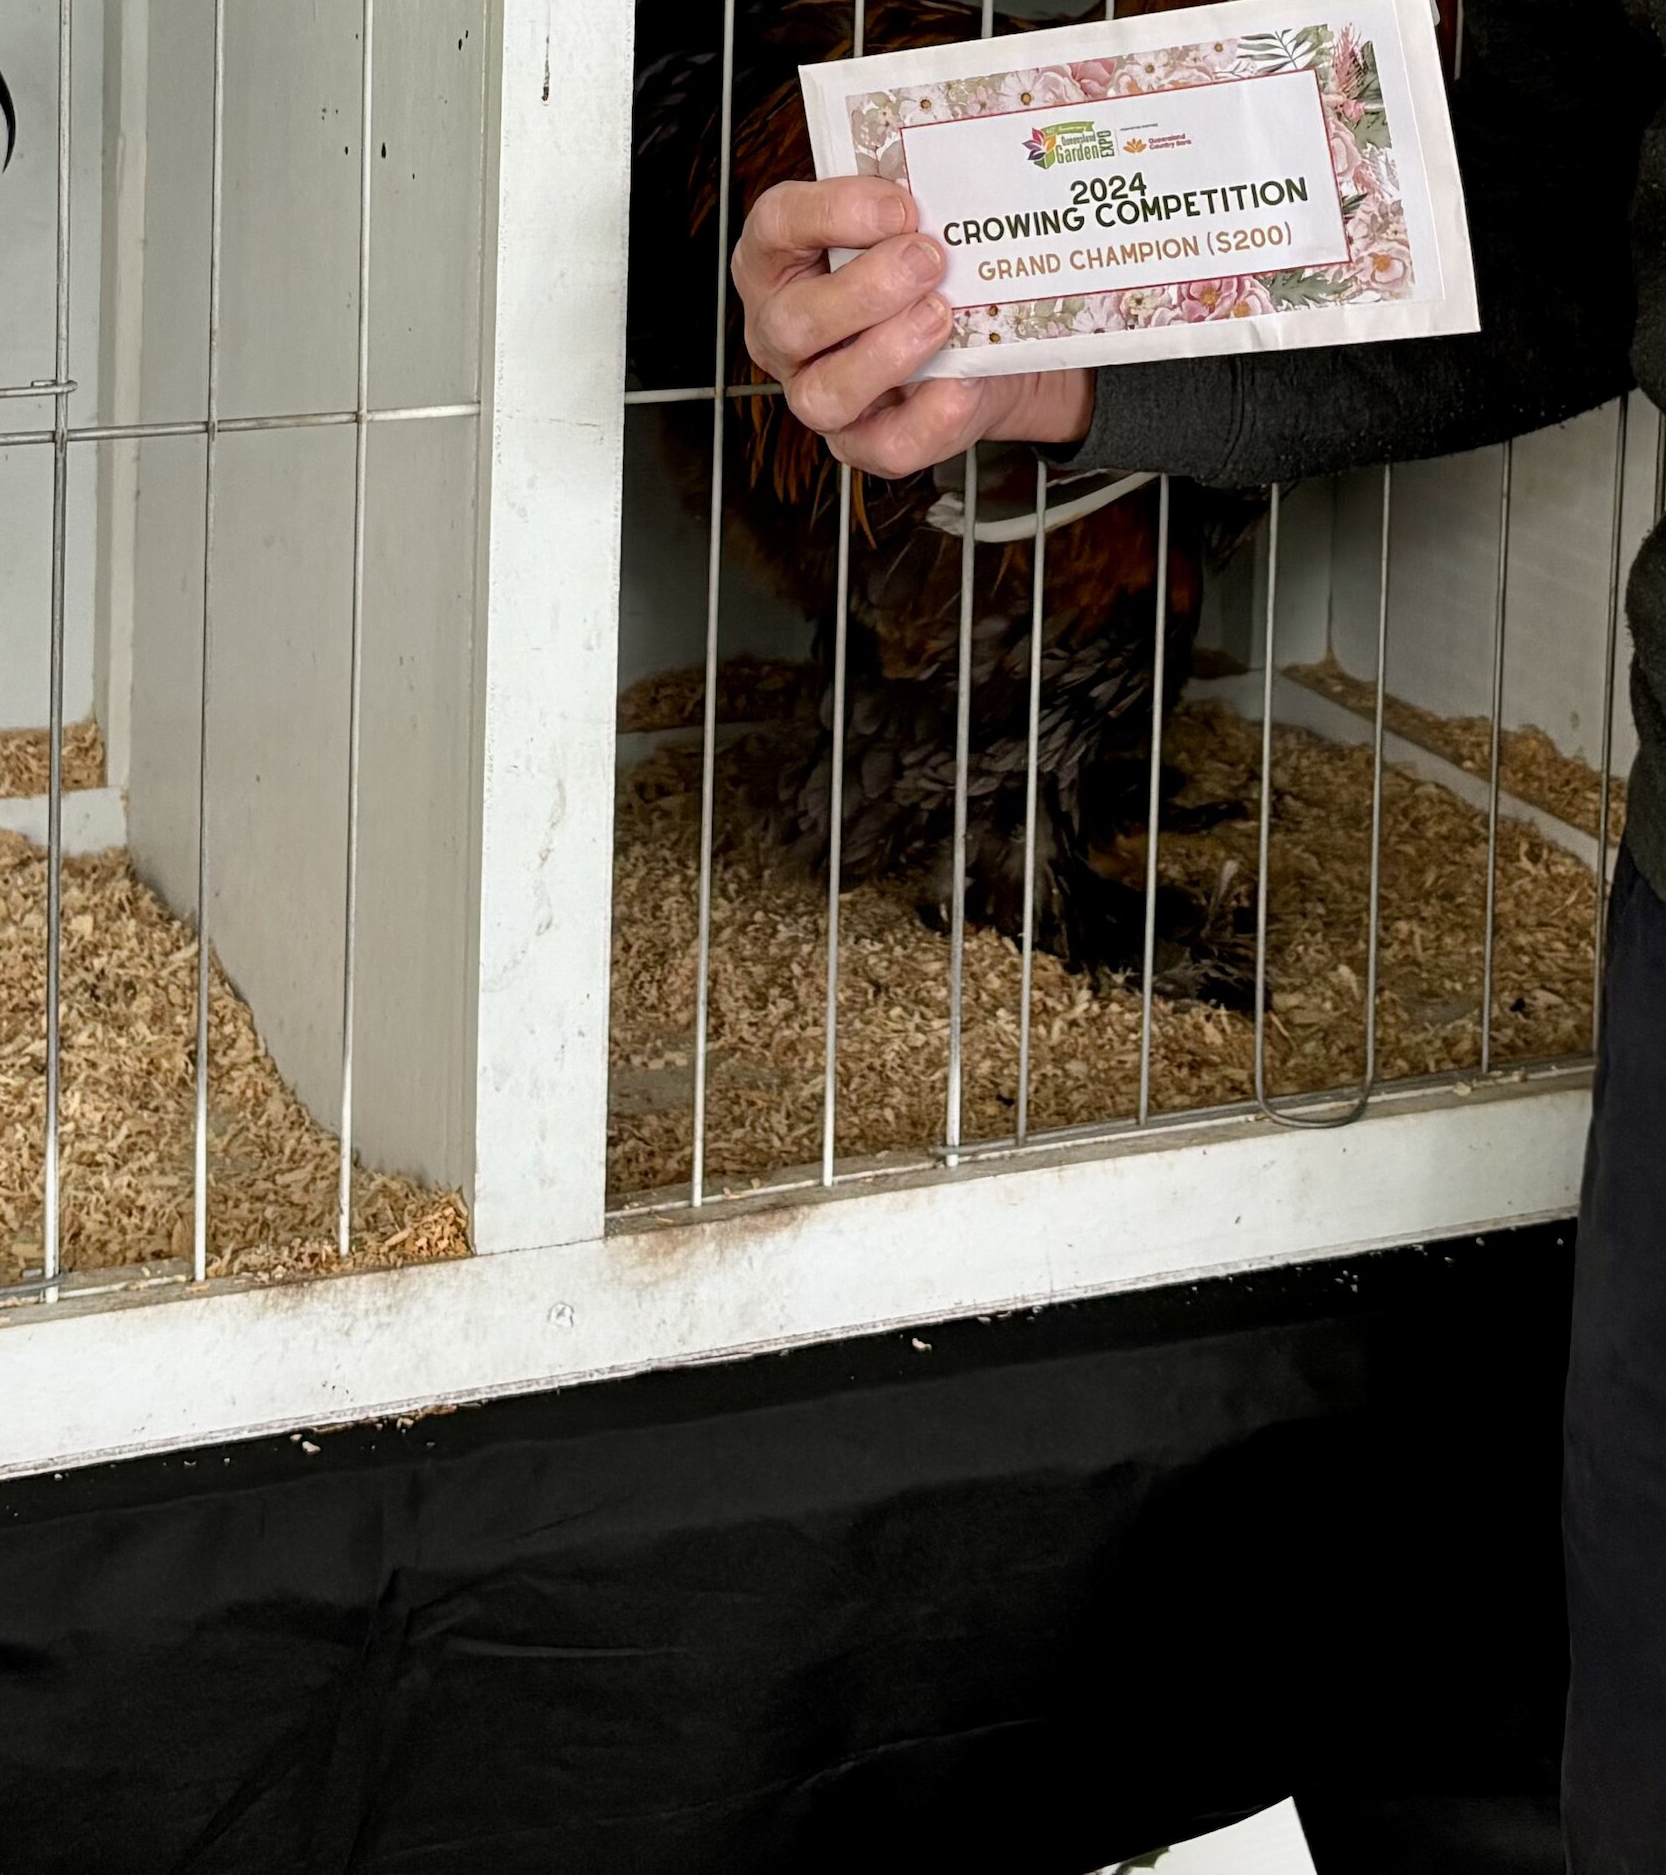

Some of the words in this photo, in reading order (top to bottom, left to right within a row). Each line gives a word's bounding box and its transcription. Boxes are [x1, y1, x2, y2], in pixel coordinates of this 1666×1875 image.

[1056, 144, 1099, 164] Garden
[1096, 130, 1114, 158] EXPO
[1070, 172, 1147, 205] 2024
[943, 206, 1084, 246] CROWING
[1095, 176, 1309, 227] COMPETITION
[978, 252, 1061, 281] GRAND
[1069, 236, 1200, 270] CHAMPION
